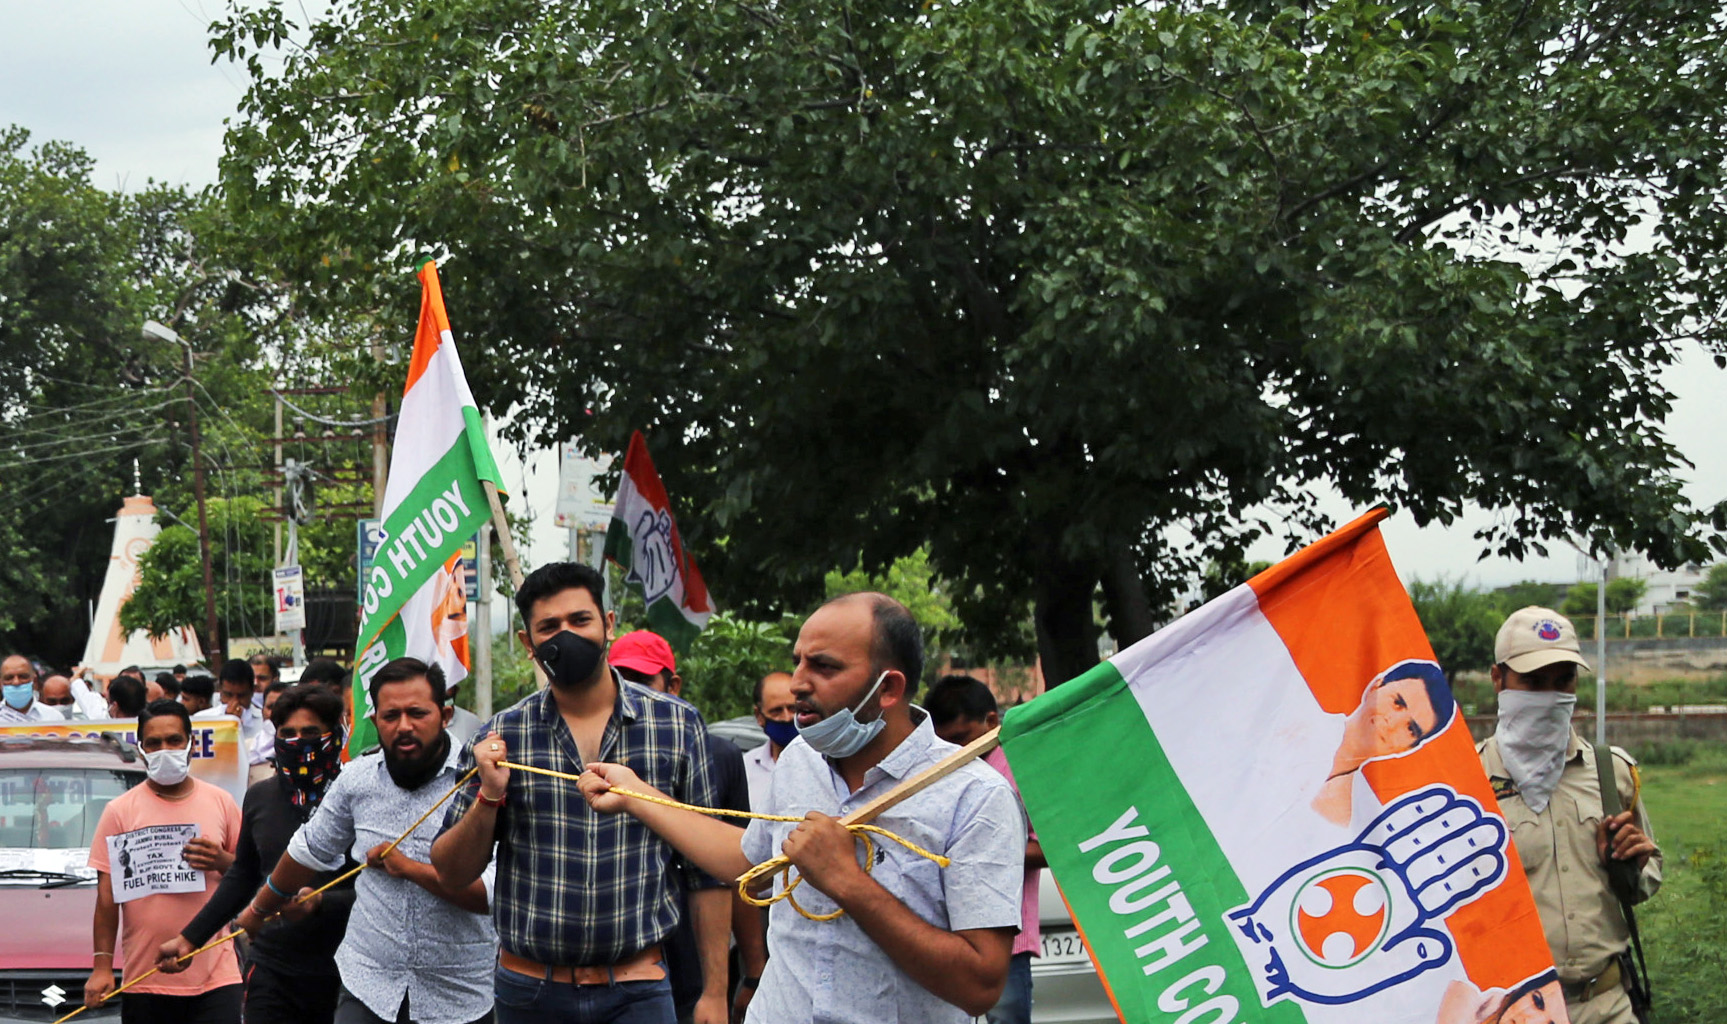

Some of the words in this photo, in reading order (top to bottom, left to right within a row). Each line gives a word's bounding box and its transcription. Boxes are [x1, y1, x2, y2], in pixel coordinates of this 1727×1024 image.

[126, 829, 150, 839] DISTRICT
[150, 826, 182, 834] CONGRESS
[129, 844, 153, 853] Protest
[155, 840, 182, 848] Protest
[135, 836, 153, 845] JAMMU
[147, 852, 164, 860] TAX
[123, 879, 146, 891] FUEL
[147, 872, 172, 884] PRICE
[174, 871, 197, 882] HIKE
[1078, 805, 1210, 976] YOUTH
